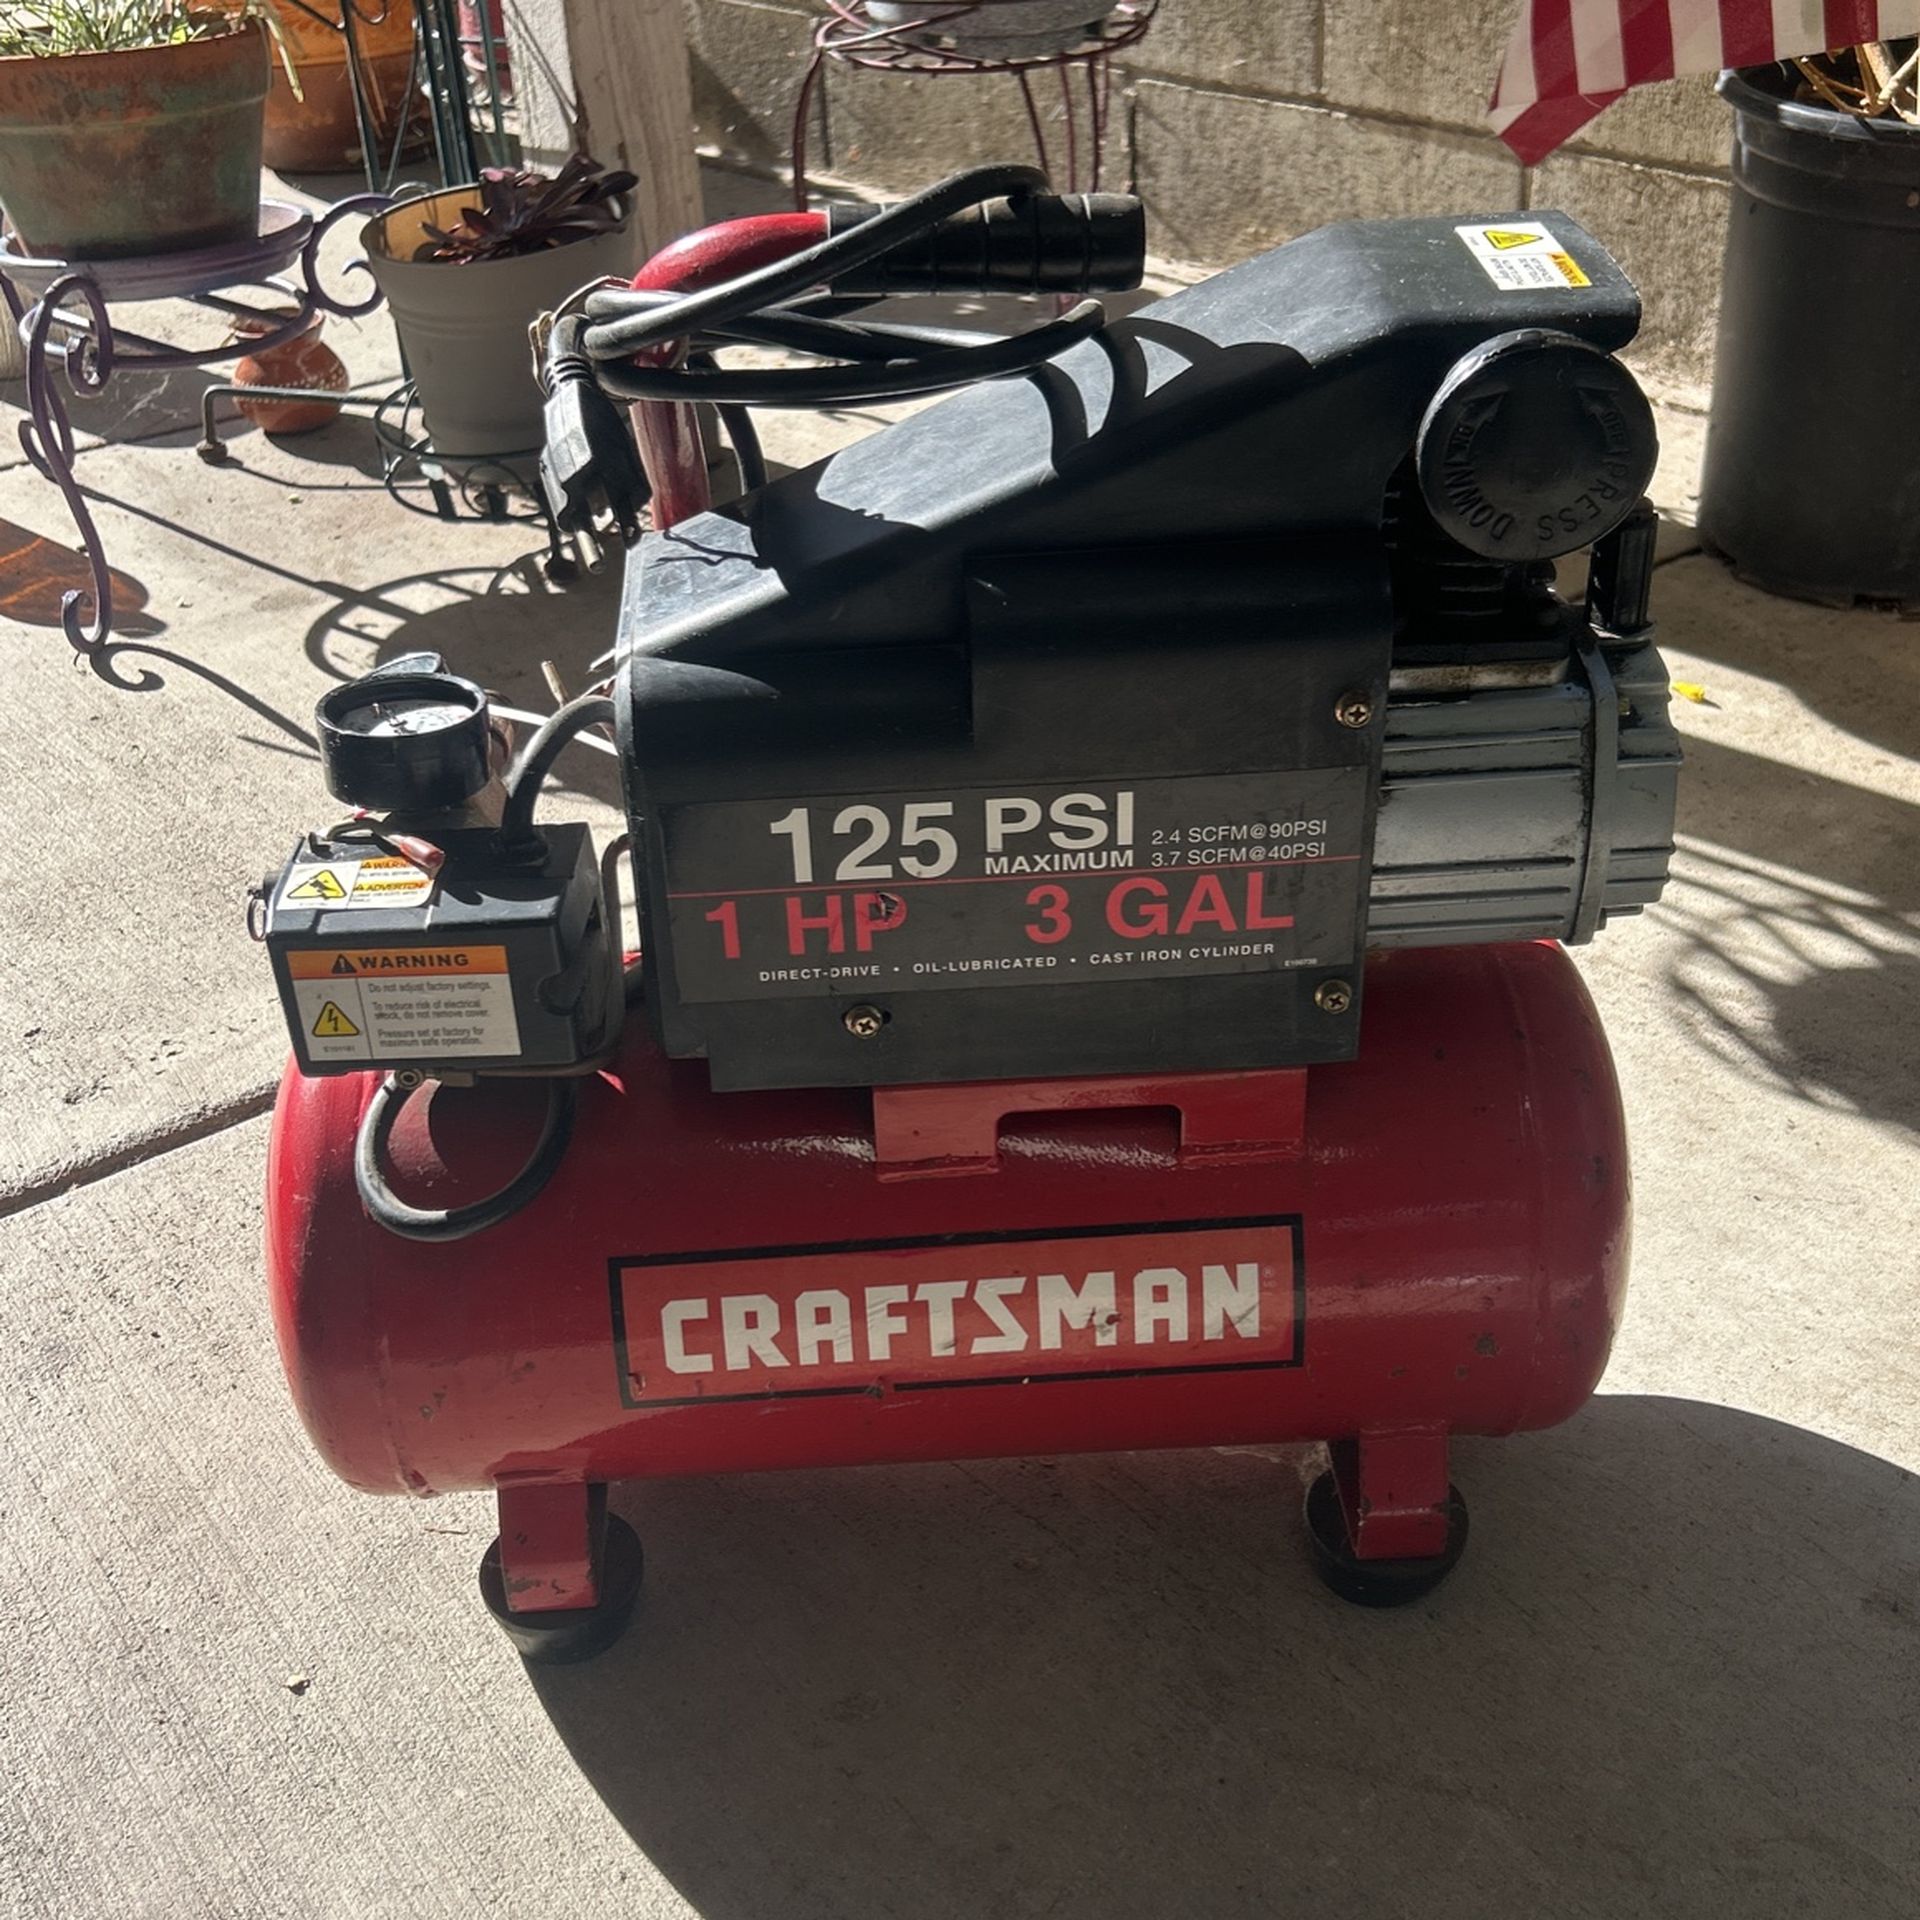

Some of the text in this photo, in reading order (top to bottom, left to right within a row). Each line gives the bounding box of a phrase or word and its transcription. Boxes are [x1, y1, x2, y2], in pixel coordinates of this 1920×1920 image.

[1443, 460, 1628, 541] PRESS DOWN
[770, 791, 1134, 884] 125 PSI
[1152, 819, 1327, 846] 2.4 SCFM@90PSI
[984, 849, 1134, 876] MAXIMUM
[1151, 842, 1326, 867] 3.7 SCFM@40PSI
[1025, 871, 1295, 944] 3 GAL
[705, 892, 907, 959] 1 HP
[359, 953, 469, 970] WARNING
[759, 943, 1276, 983] DIRECT-DRIVE OIL-LUBRICATED CAST IRON CYLINDER
[368, 983, 381, 993] Do
[383, 983, 397, 992] not
[399, 983, 425, 993] adjust
[426, 981, 455, 993] factory
[372, 999, 481, 1011] To reduce risk of electrical
[403, 1011, 414, 1020] do
[416, 1010, 430, 1019] not
[432, 1010, 463, 1019] remove
[378, 1026, 484, 1038] Pressure set at factory for
[379, 1038, 419, 1048] maximum
[421, 1037, 439, 1047] safe
[660, 1262, 1260, 1375] CRAFTSMAN
